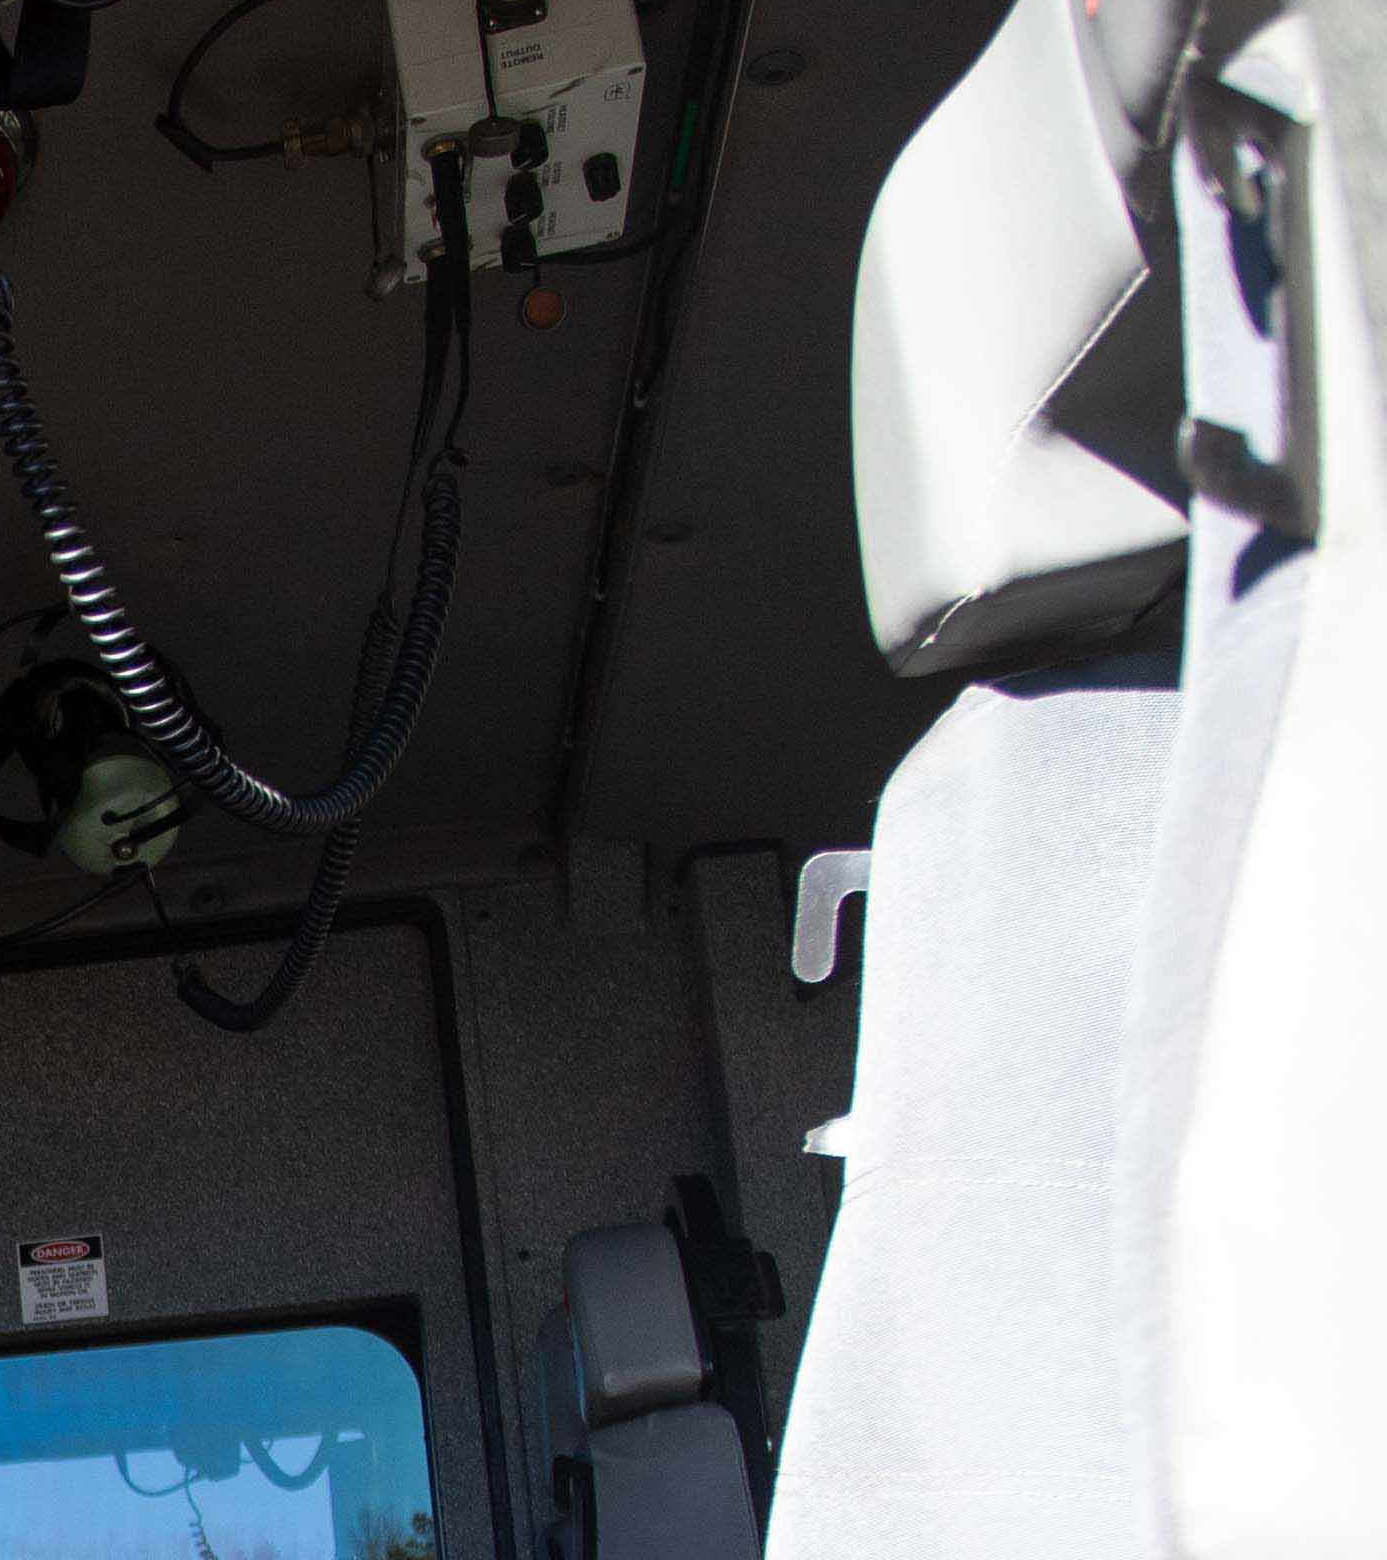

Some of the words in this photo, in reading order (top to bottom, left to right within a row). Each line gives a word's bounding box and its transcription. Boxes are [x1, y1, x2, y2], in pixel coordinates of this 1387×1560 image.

[500, 43, 542, 60] OUTPUT
[500, 52, 545, 70] REMOTE
[36, 1245, 84, 1258] DANGER
